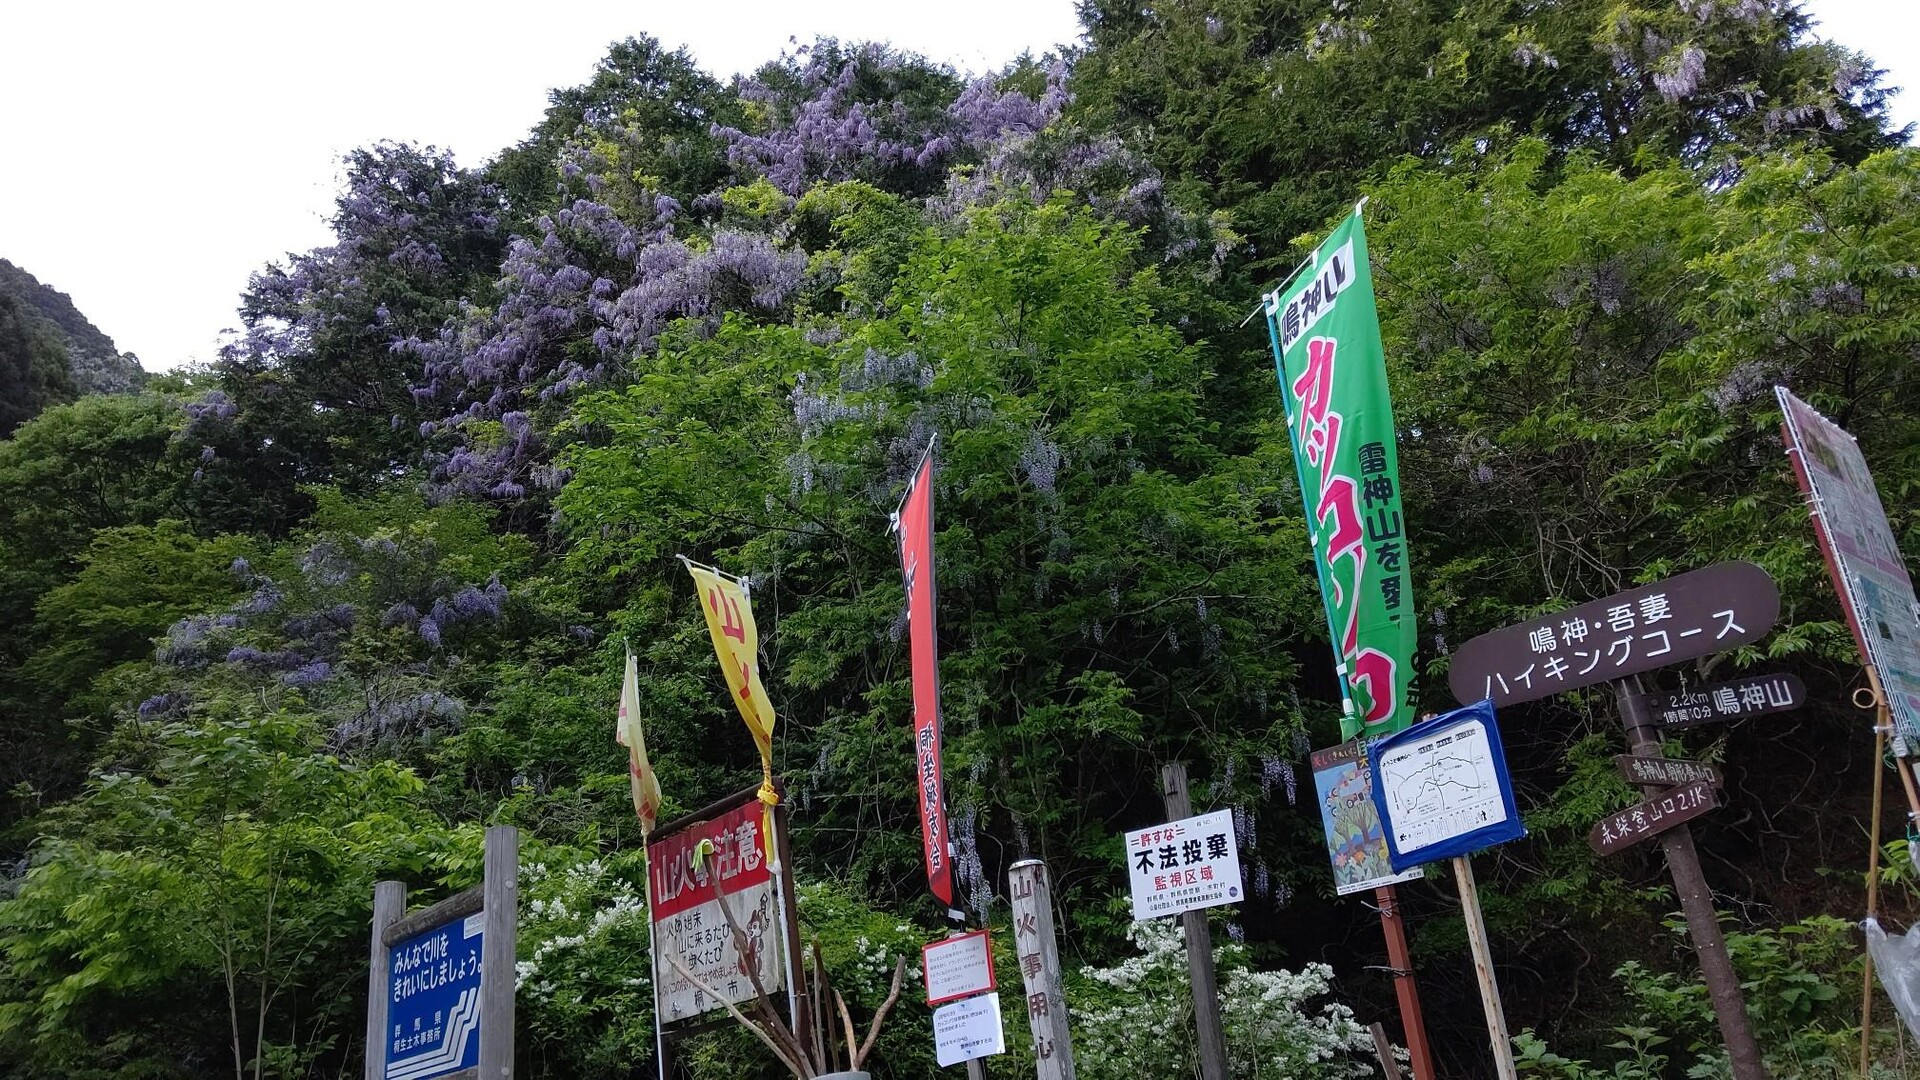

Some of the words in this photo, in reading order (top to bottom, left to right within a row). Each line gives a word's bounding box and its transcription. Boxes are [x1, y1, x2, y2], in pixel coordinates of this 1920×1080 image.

[1282, 255, 1346, 346] 鳴神山
[1529, 592, 1672, 654] 鳴神・吾妻
[1486, 609, 1746, 700] ハイキングコース
[1670, 693, 1709, 708] 2.2Km
[1712, 680, 1794, 715] 鳴神山
[1632, 759, 1667, 781] 鳴神山
[1134, 833, 1229, 875] 不法投棄
[1155, 865, 1214, 891] 監視区域
[667, 911, 702, 939] 火の始末
[394, 933, 449, 974] みんなで川を
[1013, 875, 1054, 1060] 山火事用心
[394, 949, 482, 1003] きれいにしましょう。
[393, 1026, 441, 1054] 桐生土木事務所
[395, 1010, 441, 1038] 群馬県
